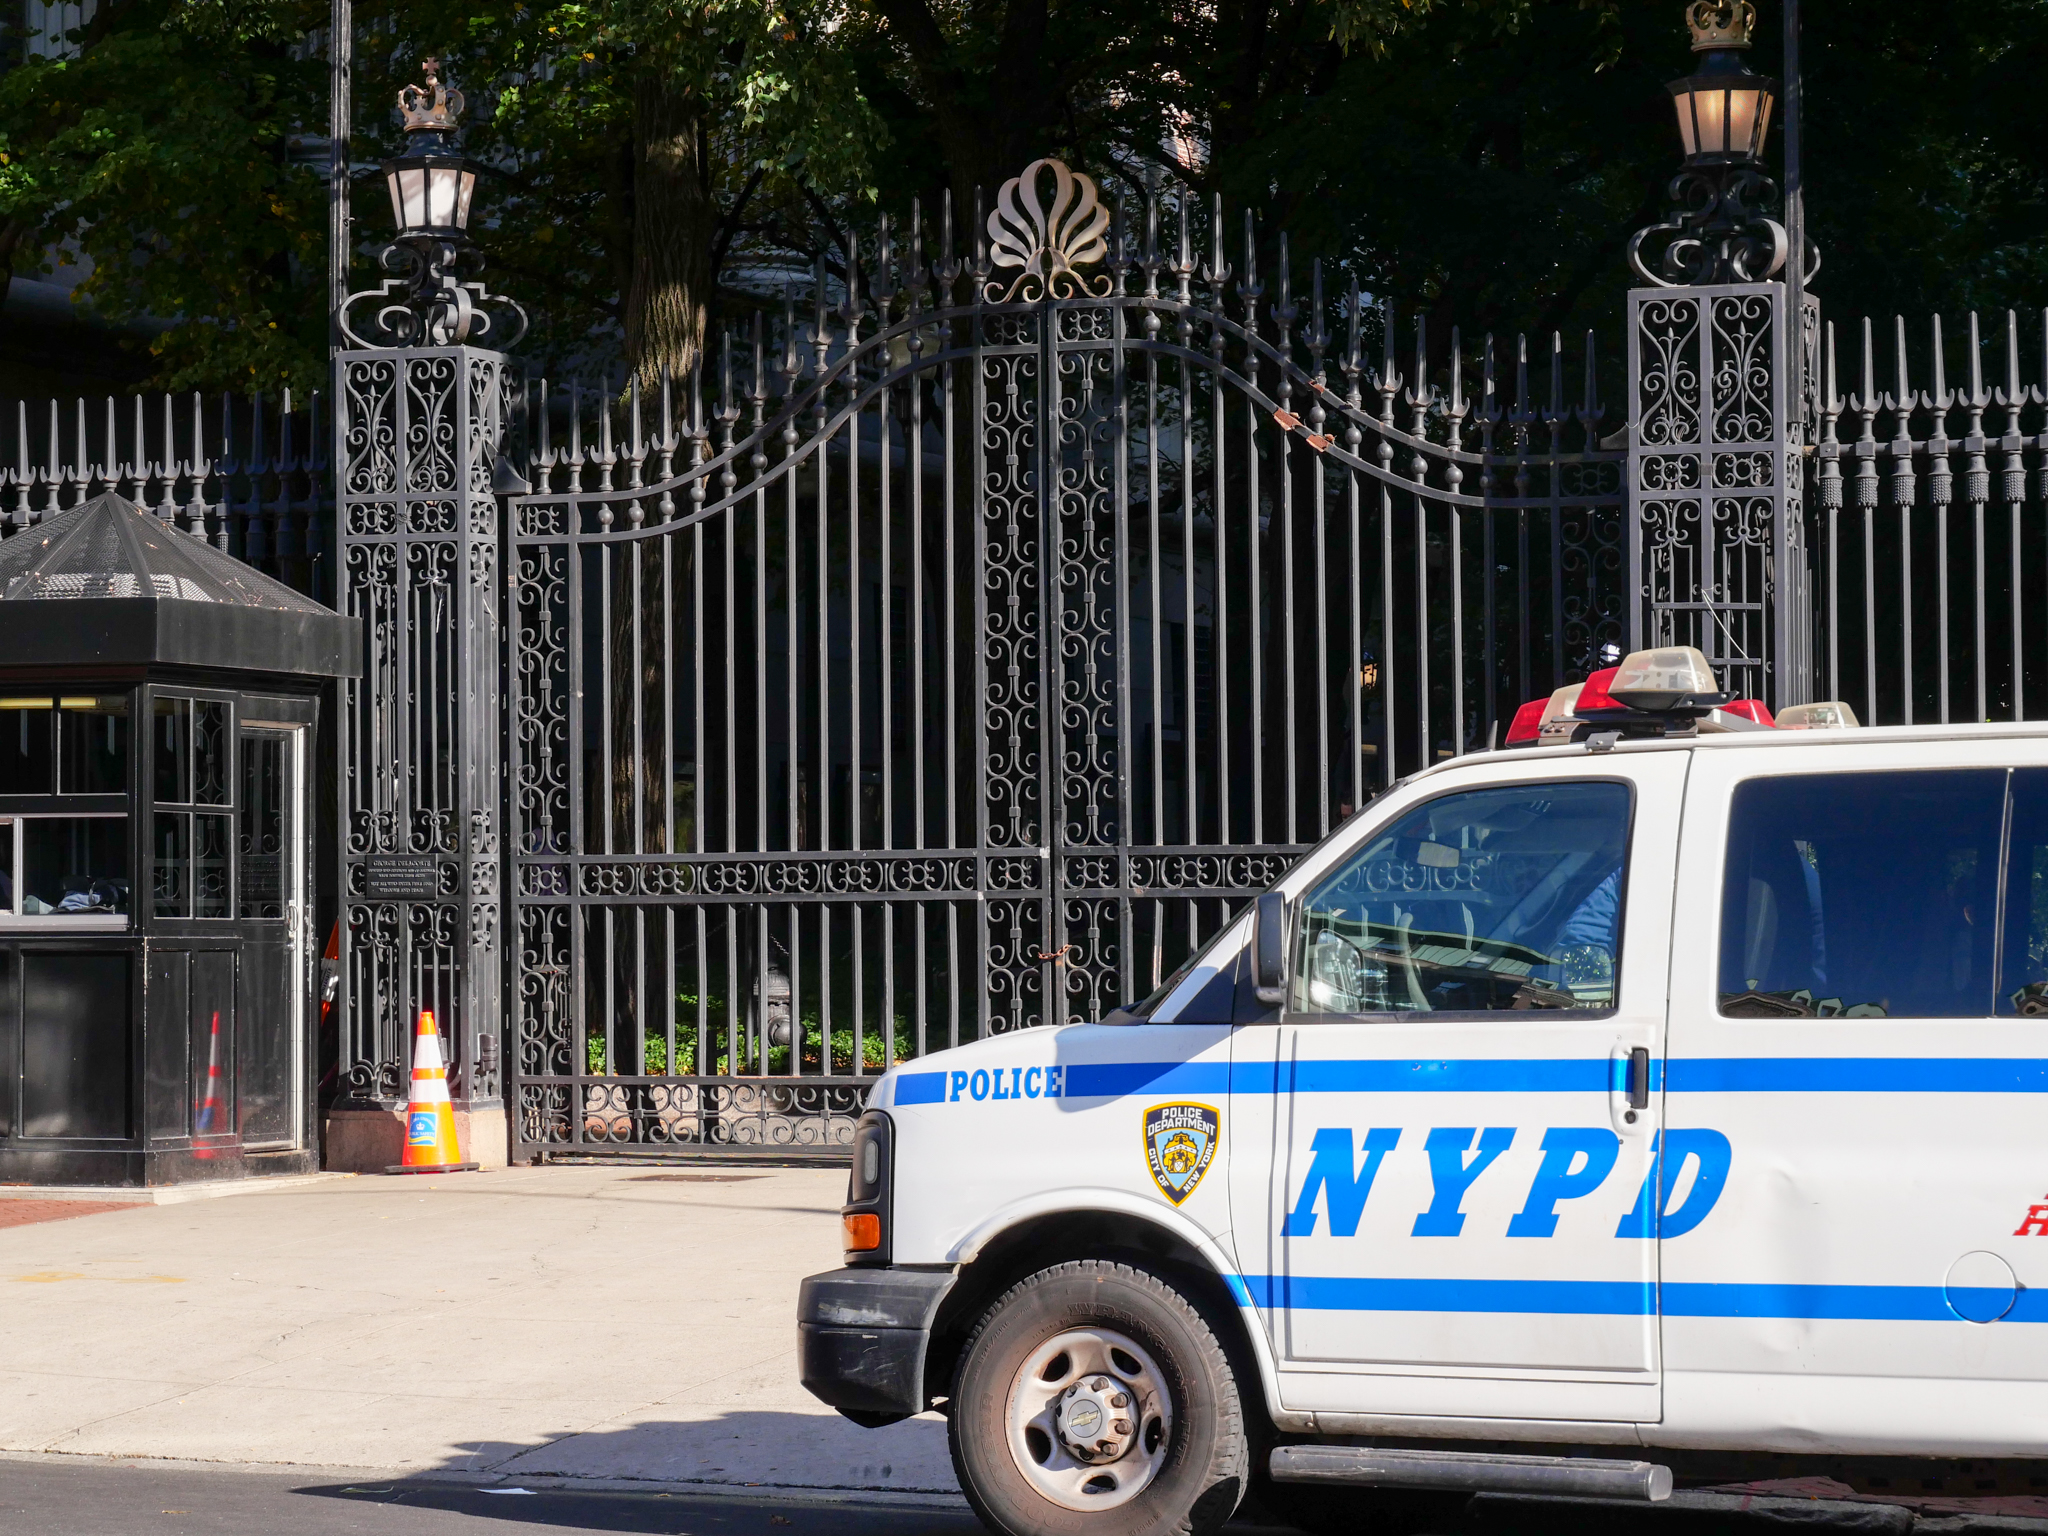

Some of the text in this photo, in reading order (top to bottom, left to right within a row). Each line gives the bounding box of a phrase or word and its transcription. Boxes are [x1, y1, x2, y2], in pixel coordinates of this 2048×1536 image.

[949, 1065, 1063, 1103] POLICE
[1147, 1117, 1216, 1137] DEPARTMENT
[1161, 1106, 1203, 1120] POLICE
[1148, 1141, 1215, 1193] CITY OF NEW YORK
[1280, 1127, 1733, 1239] NYPD
[978, 1392, 1082, 1532] GOODYEAR
